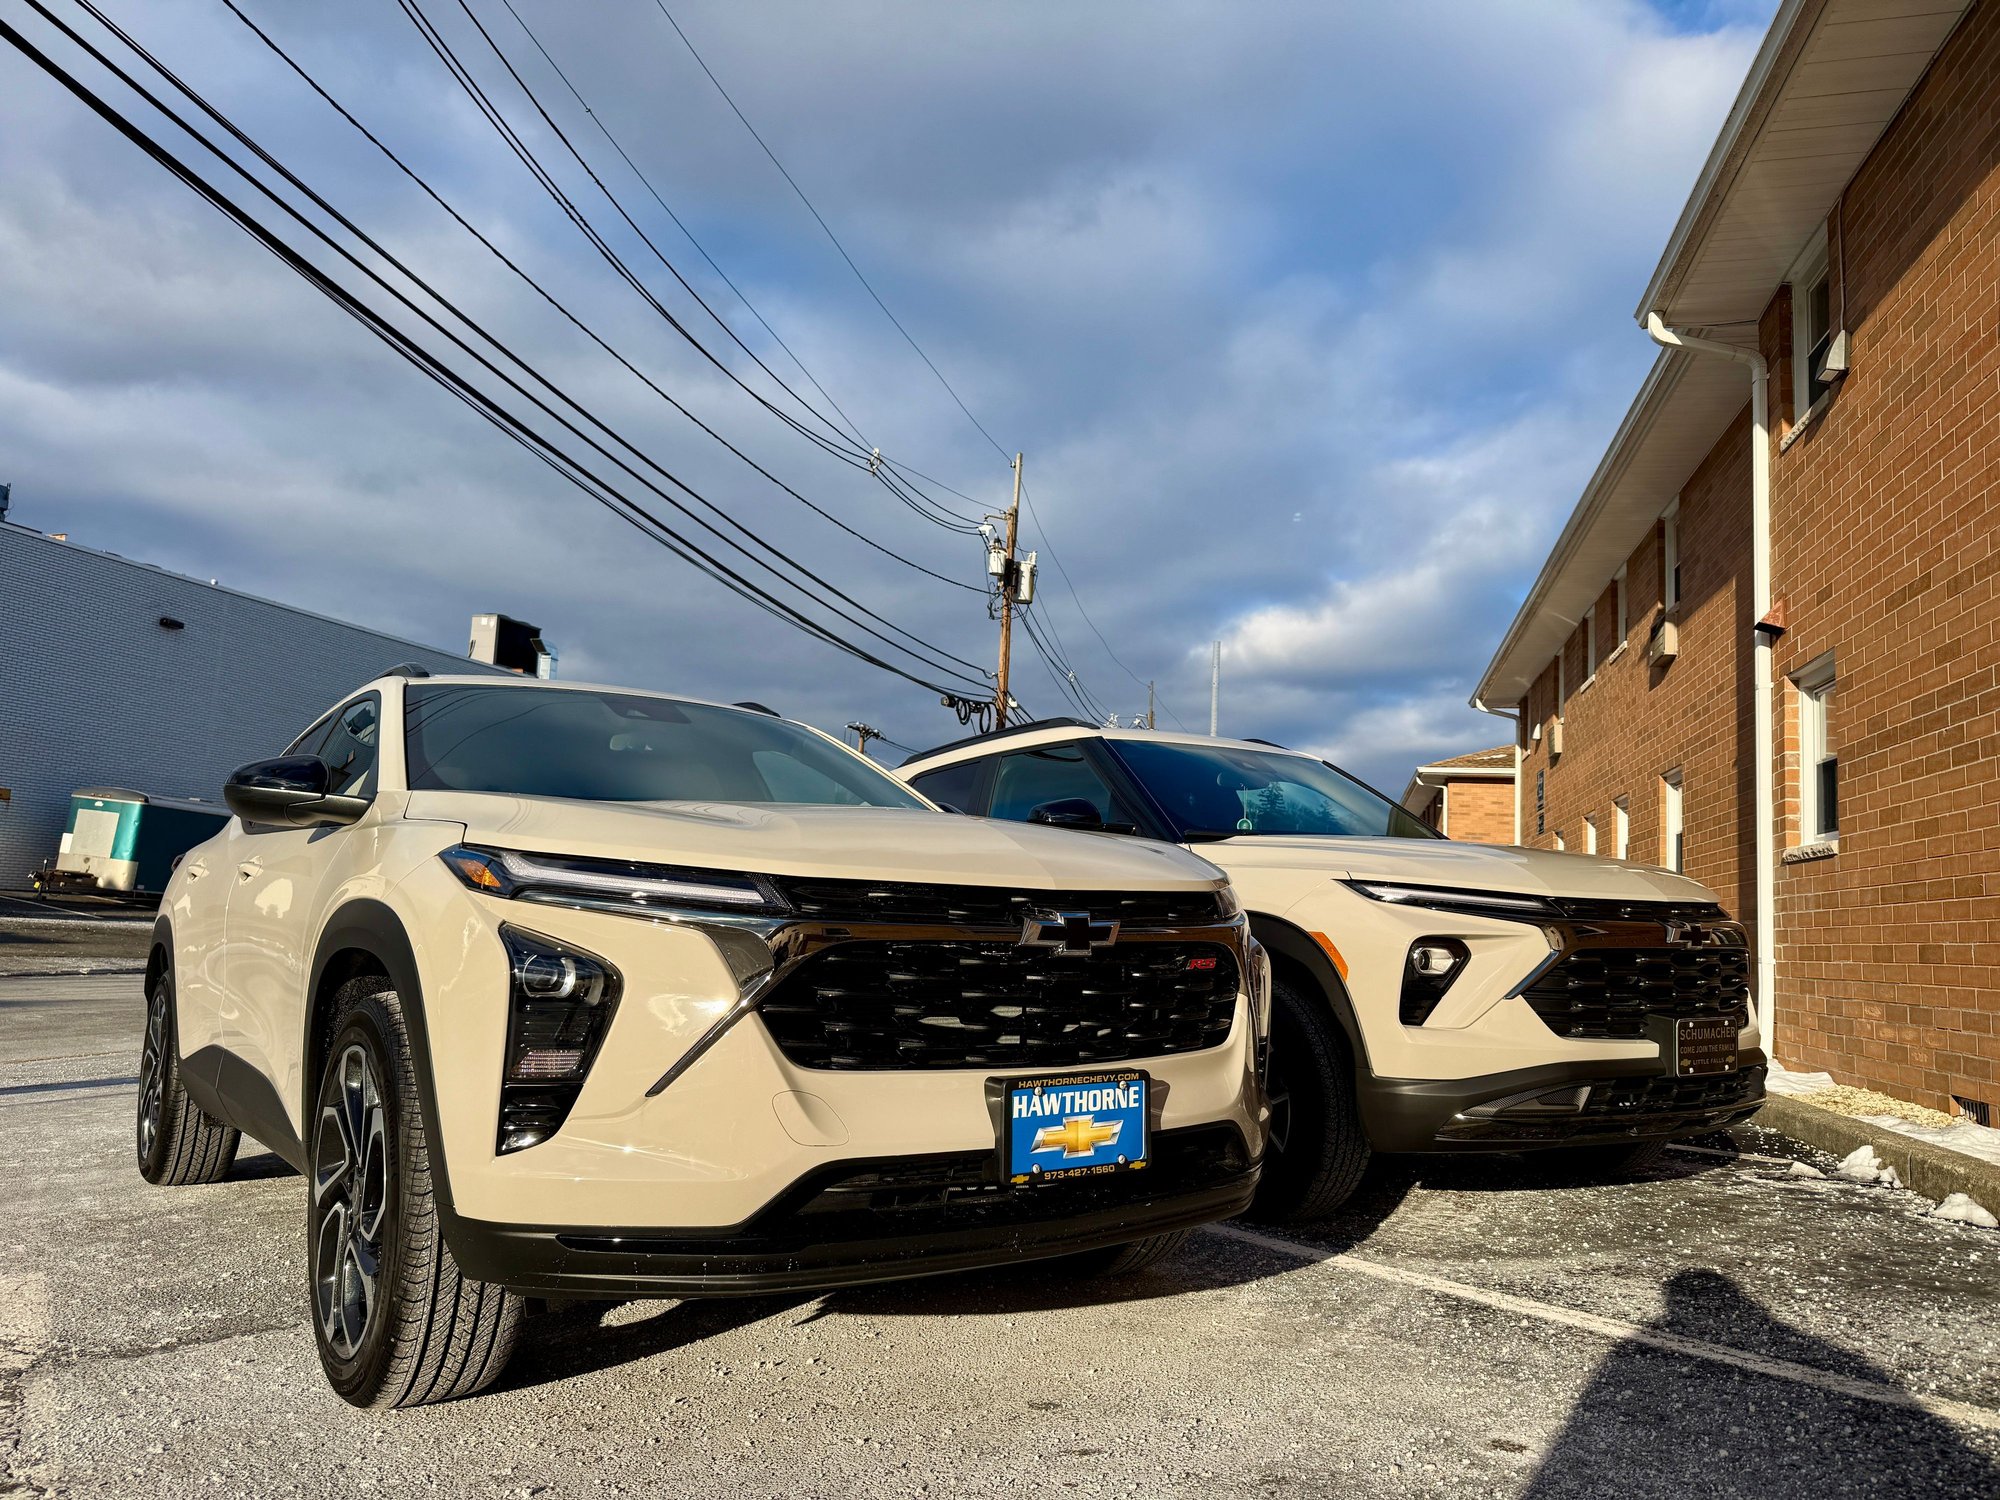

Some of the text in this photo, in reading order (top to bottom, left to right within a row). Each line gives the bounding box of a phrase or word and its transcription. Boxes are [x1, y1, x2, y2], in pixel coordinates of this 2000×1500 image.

[1187, 958, 1216, 969] RS
[1680, 1027, 1736, 1040] SCHUMACHER
[1680, 1046, 1695, 1054] COME
[1696, 1045, 1708, 1053] JOIN
[1018, 1073, 1139, 1089] HAWTHORNECHEVY.COM
[1012, 1086, 1139, 1119] HAWTHORNE
